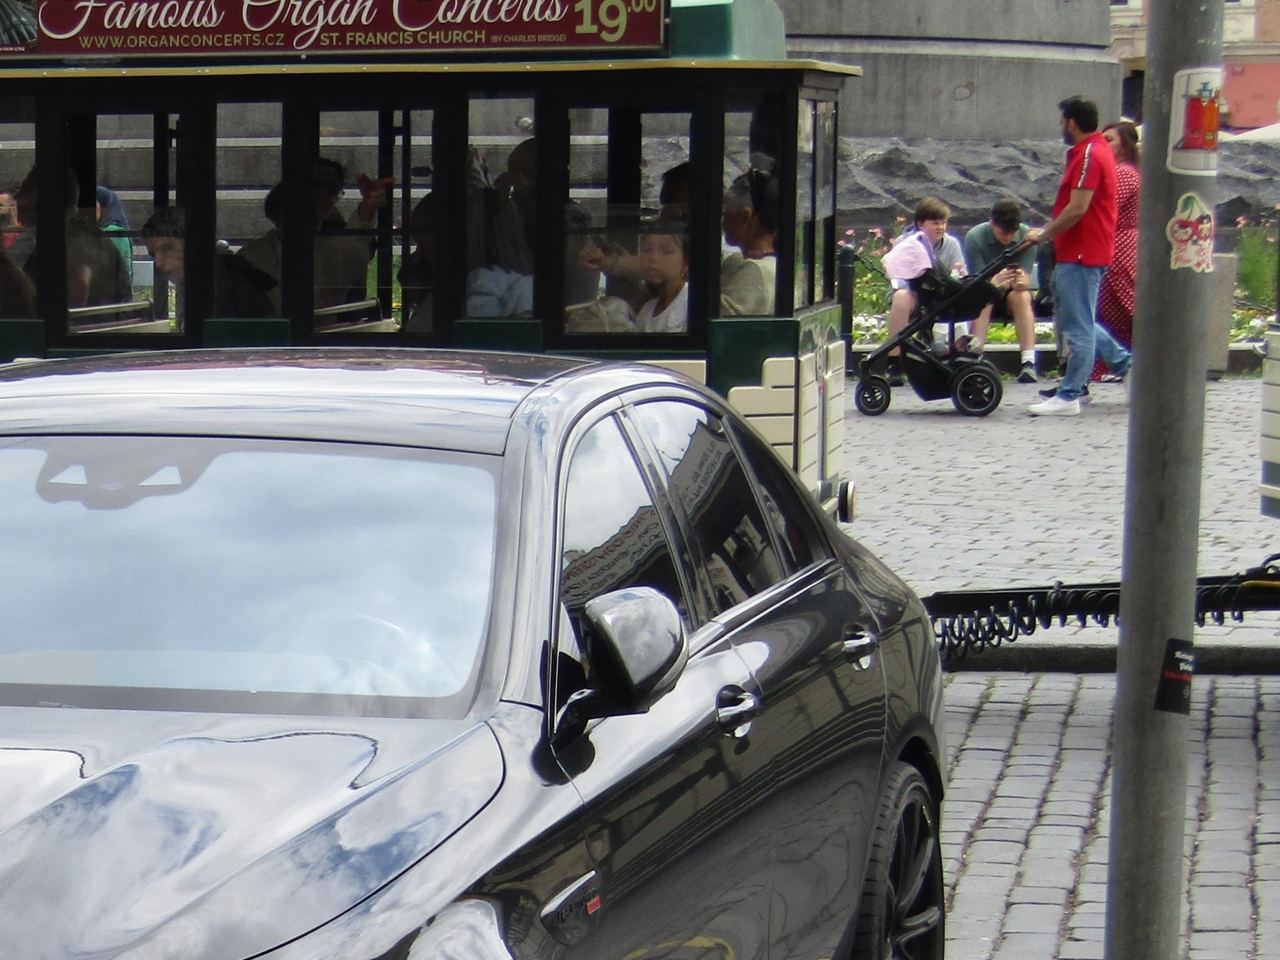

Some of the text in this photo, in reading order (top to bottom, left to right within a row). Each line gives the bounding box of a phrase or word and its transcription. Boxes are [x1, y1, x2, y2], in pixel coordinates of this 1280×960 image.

[38, 0, 569, 50] Famous Organ Concerts
[78, 33, 285, 48] WWW.ORGANCONCERTS.CZ
[320, 32, 342, 46] ST.
[346, 31, 414, 45] FRANCIS
[417, 30, 486, 44] CHURCH
[503, 34, 537, 43] CHARLES
